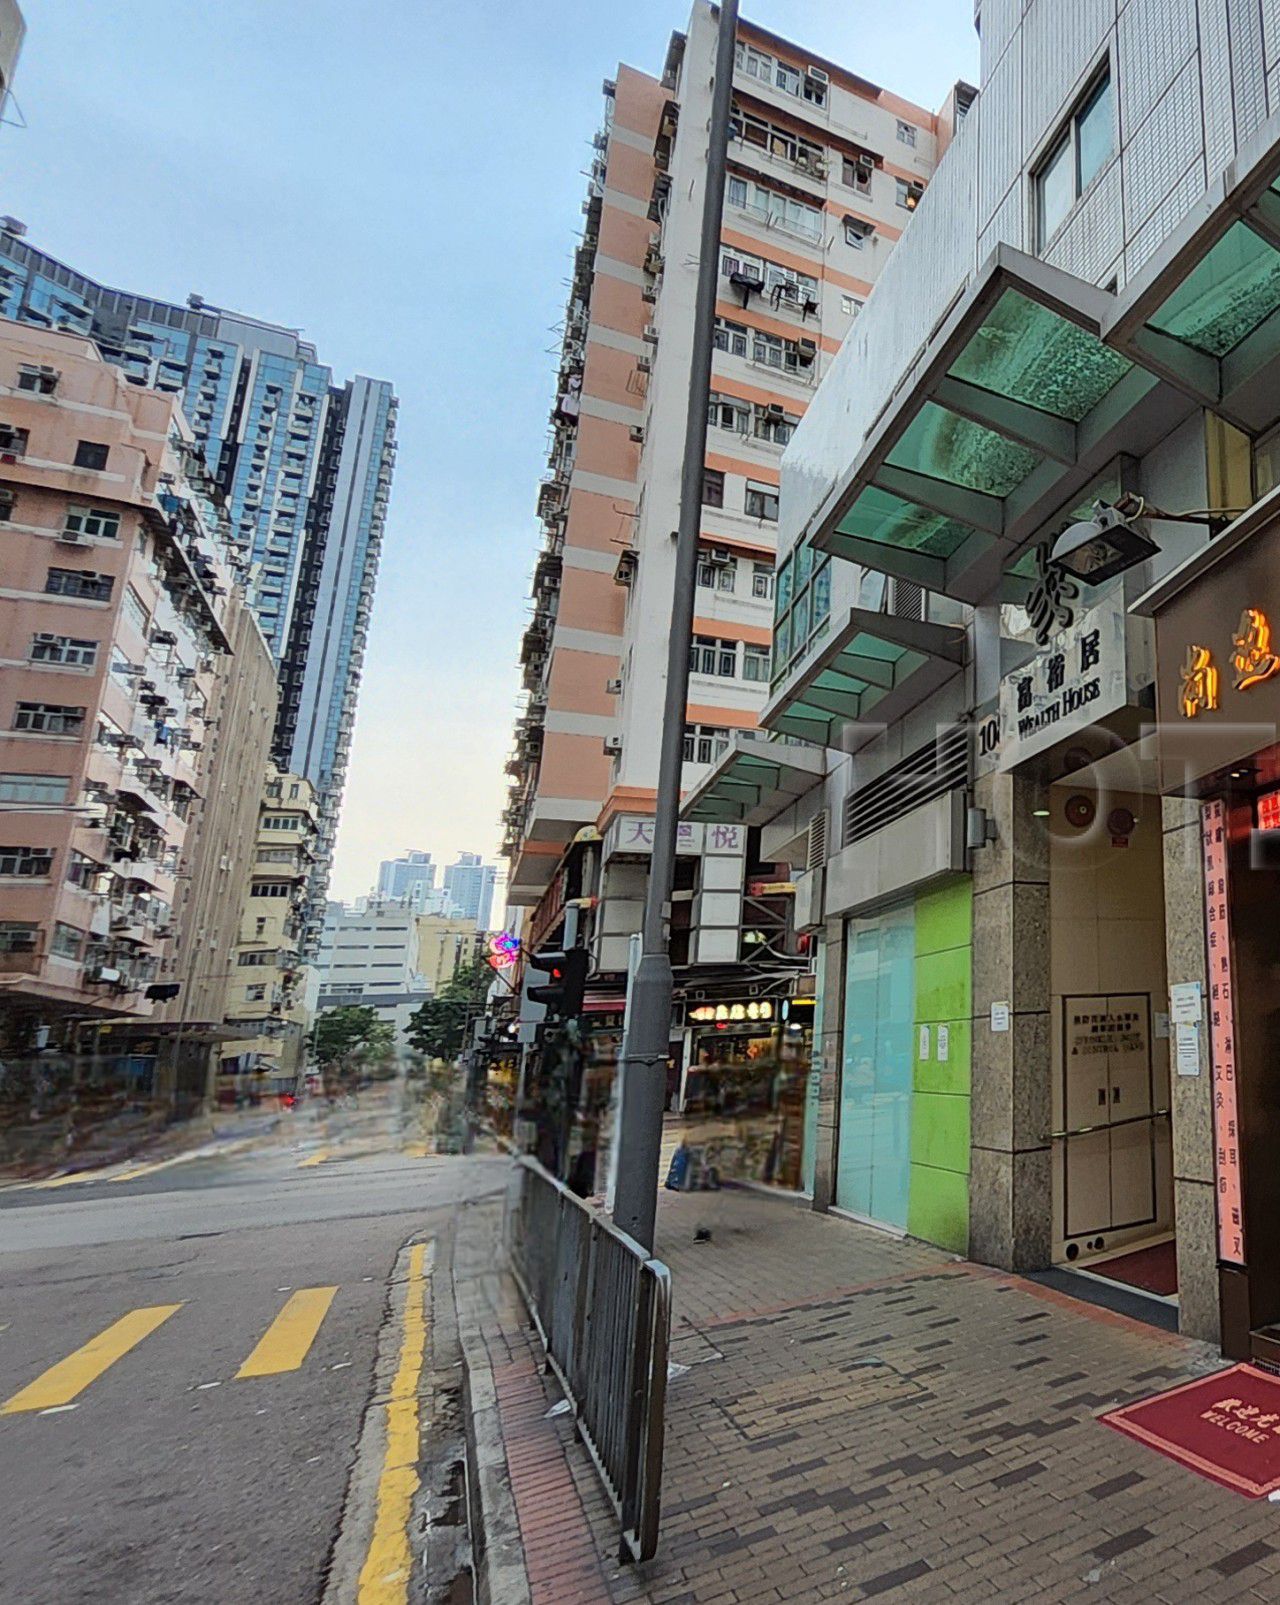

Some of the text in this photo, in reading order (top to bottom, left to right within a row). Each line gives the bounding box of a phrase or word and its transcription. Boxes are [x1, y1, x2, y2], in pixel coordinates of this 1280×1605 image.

[1017, 629, 1100, 713] 富裕居
[1063, 677, 1100, 716] HOUSE
[1200, 1410, 1270, 1444] WELCOME
